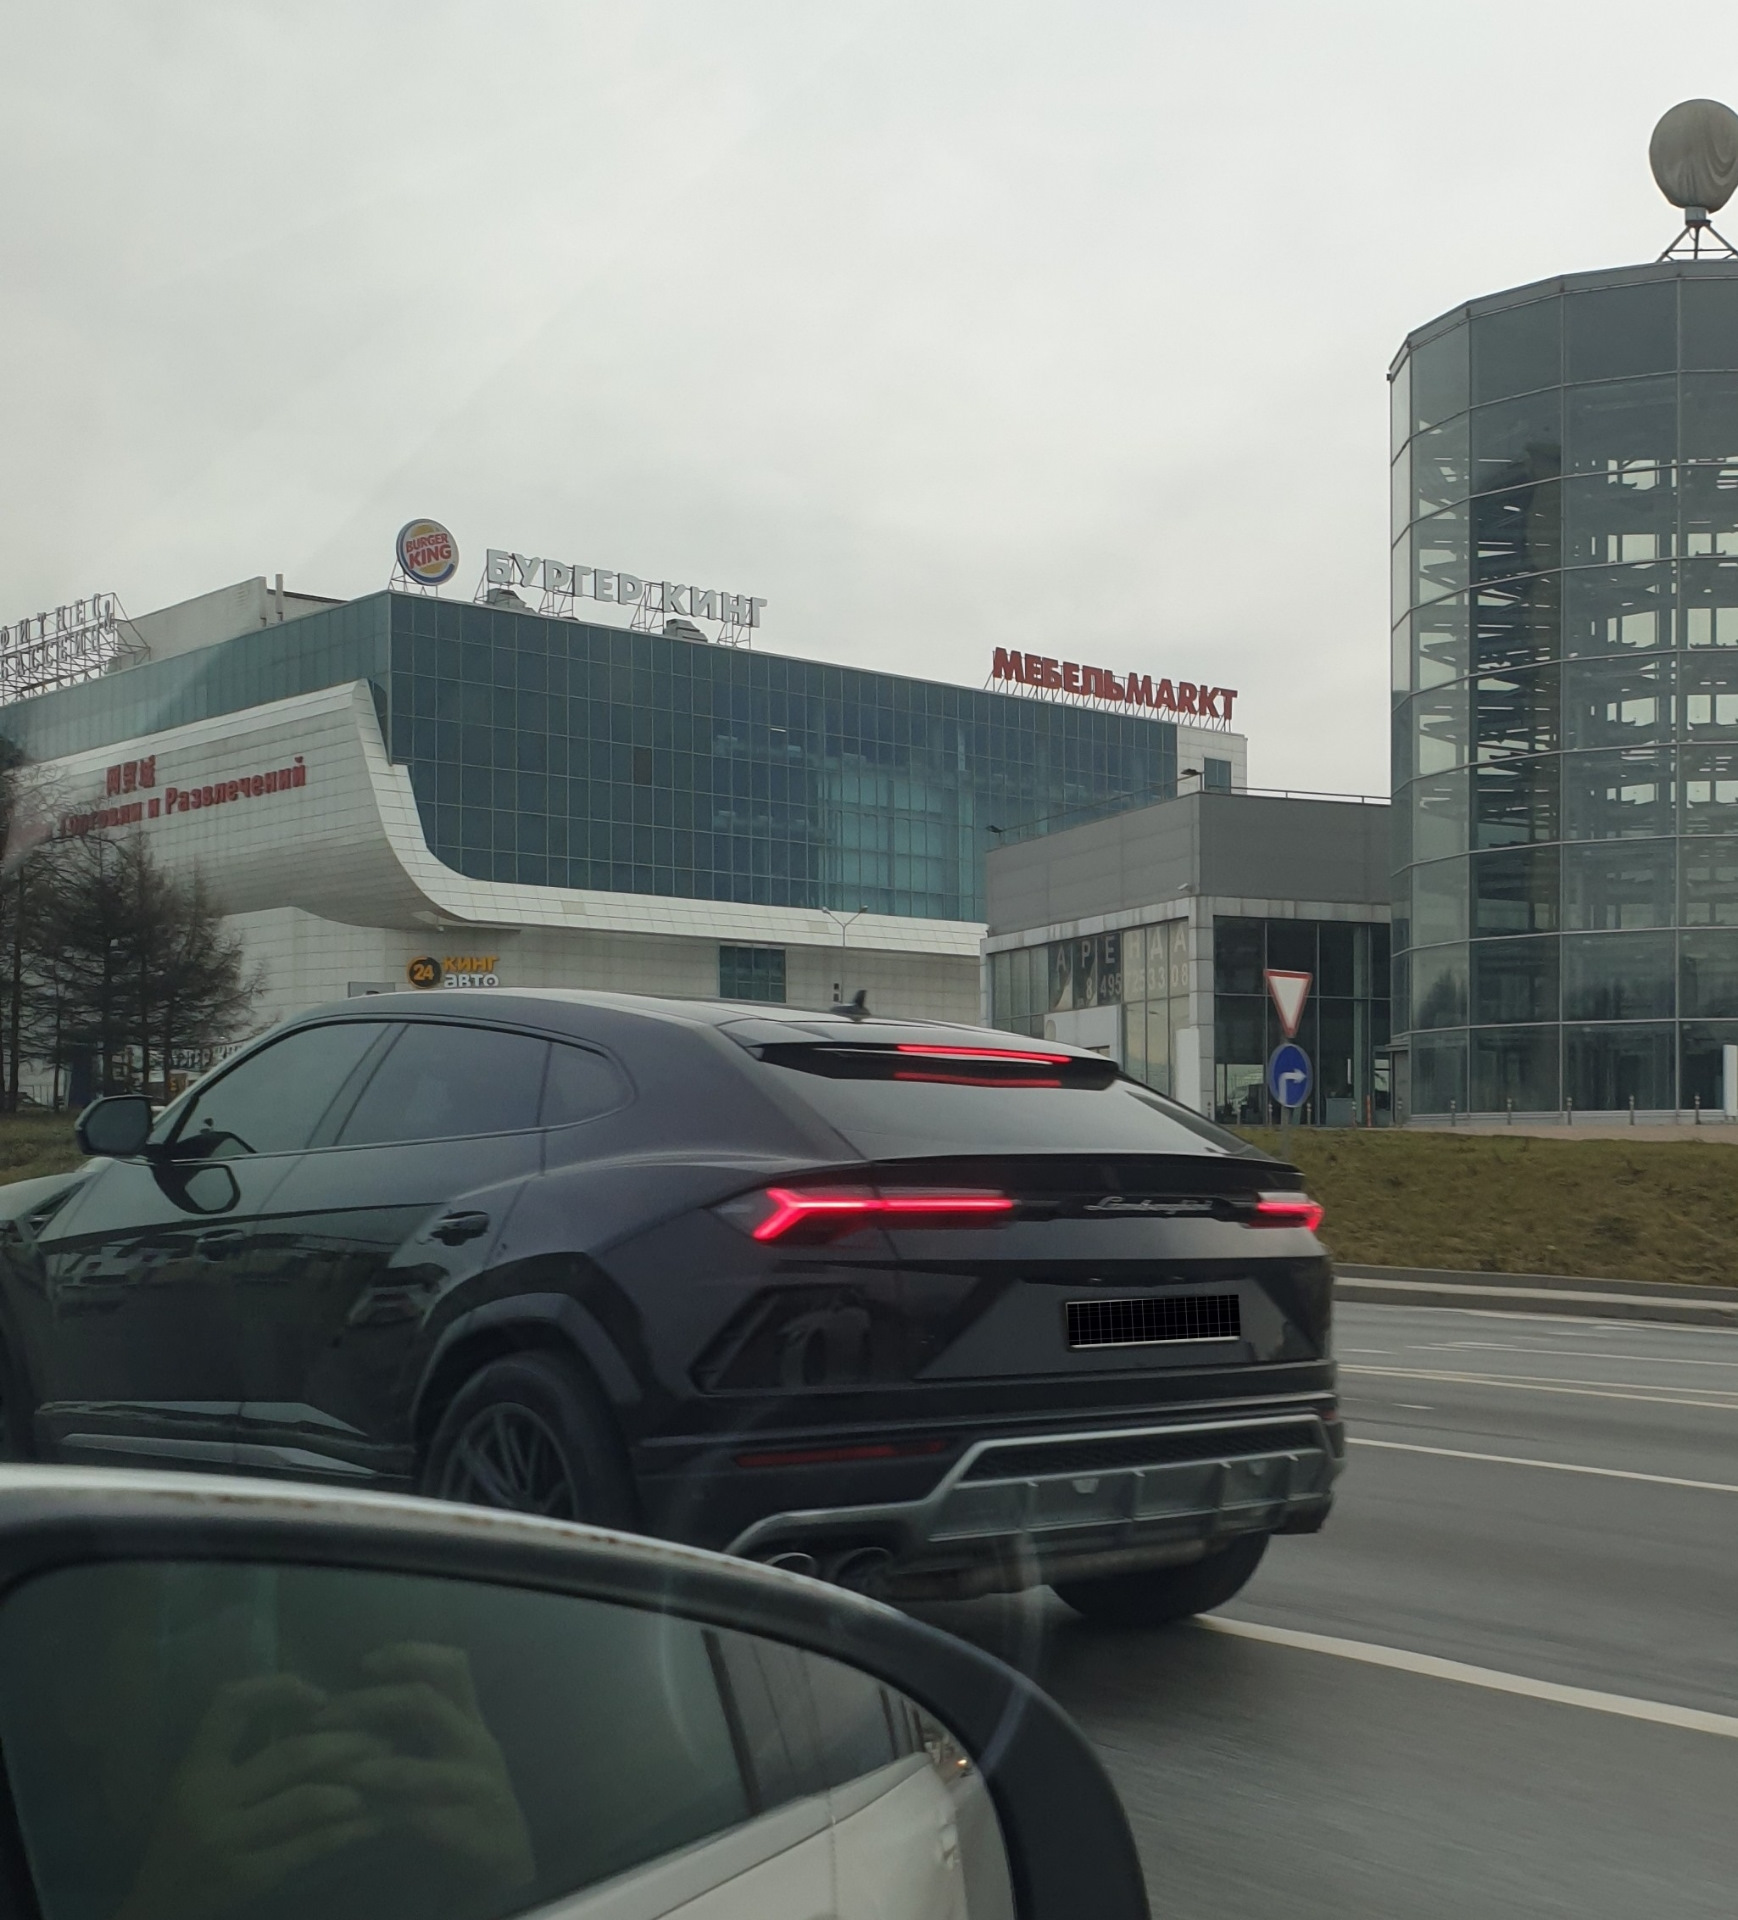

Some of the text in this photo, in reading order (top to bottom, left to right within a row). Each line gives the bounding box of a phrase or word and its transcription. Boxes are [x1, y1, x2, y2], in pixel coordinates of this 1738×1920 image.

[406, 533, 448, 553] BURGER
[409, 544, 452, 569] KING
[486, 548, 768, 628] БУРГЕР КИНГ
[165, 756, 306, 814] Развлечений
[413, 964, 435, 980] 24
[1100, 973, 1122, 997] 495
